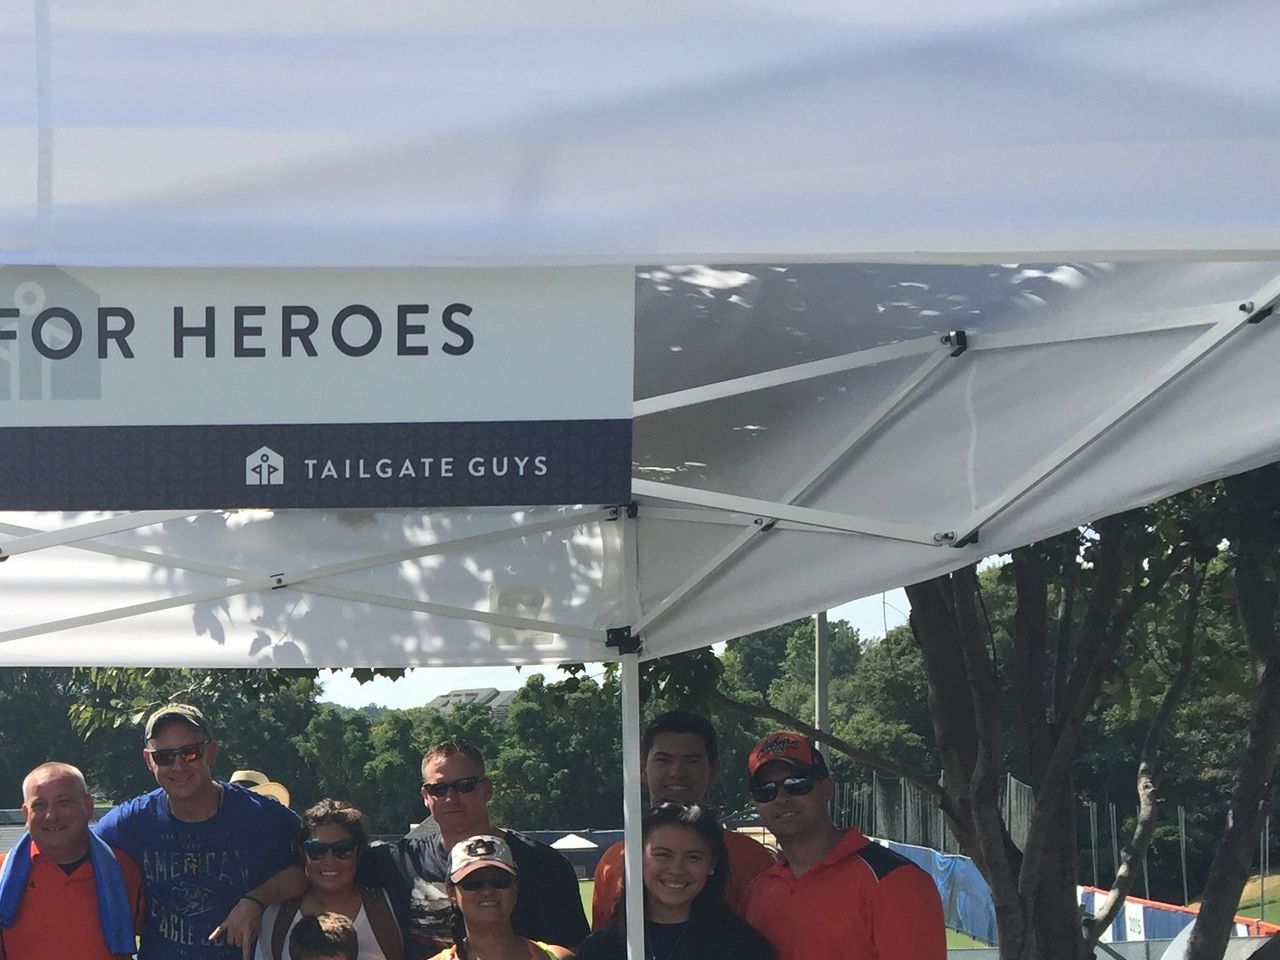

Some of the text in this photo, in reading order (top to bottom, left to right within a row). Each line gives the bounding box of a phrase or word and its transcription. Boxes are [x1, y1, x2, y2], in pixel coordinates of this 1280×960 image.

[173, 302, 476, 359] HEROES
[304, 456, 548, 479] TAILGATE GUYS
